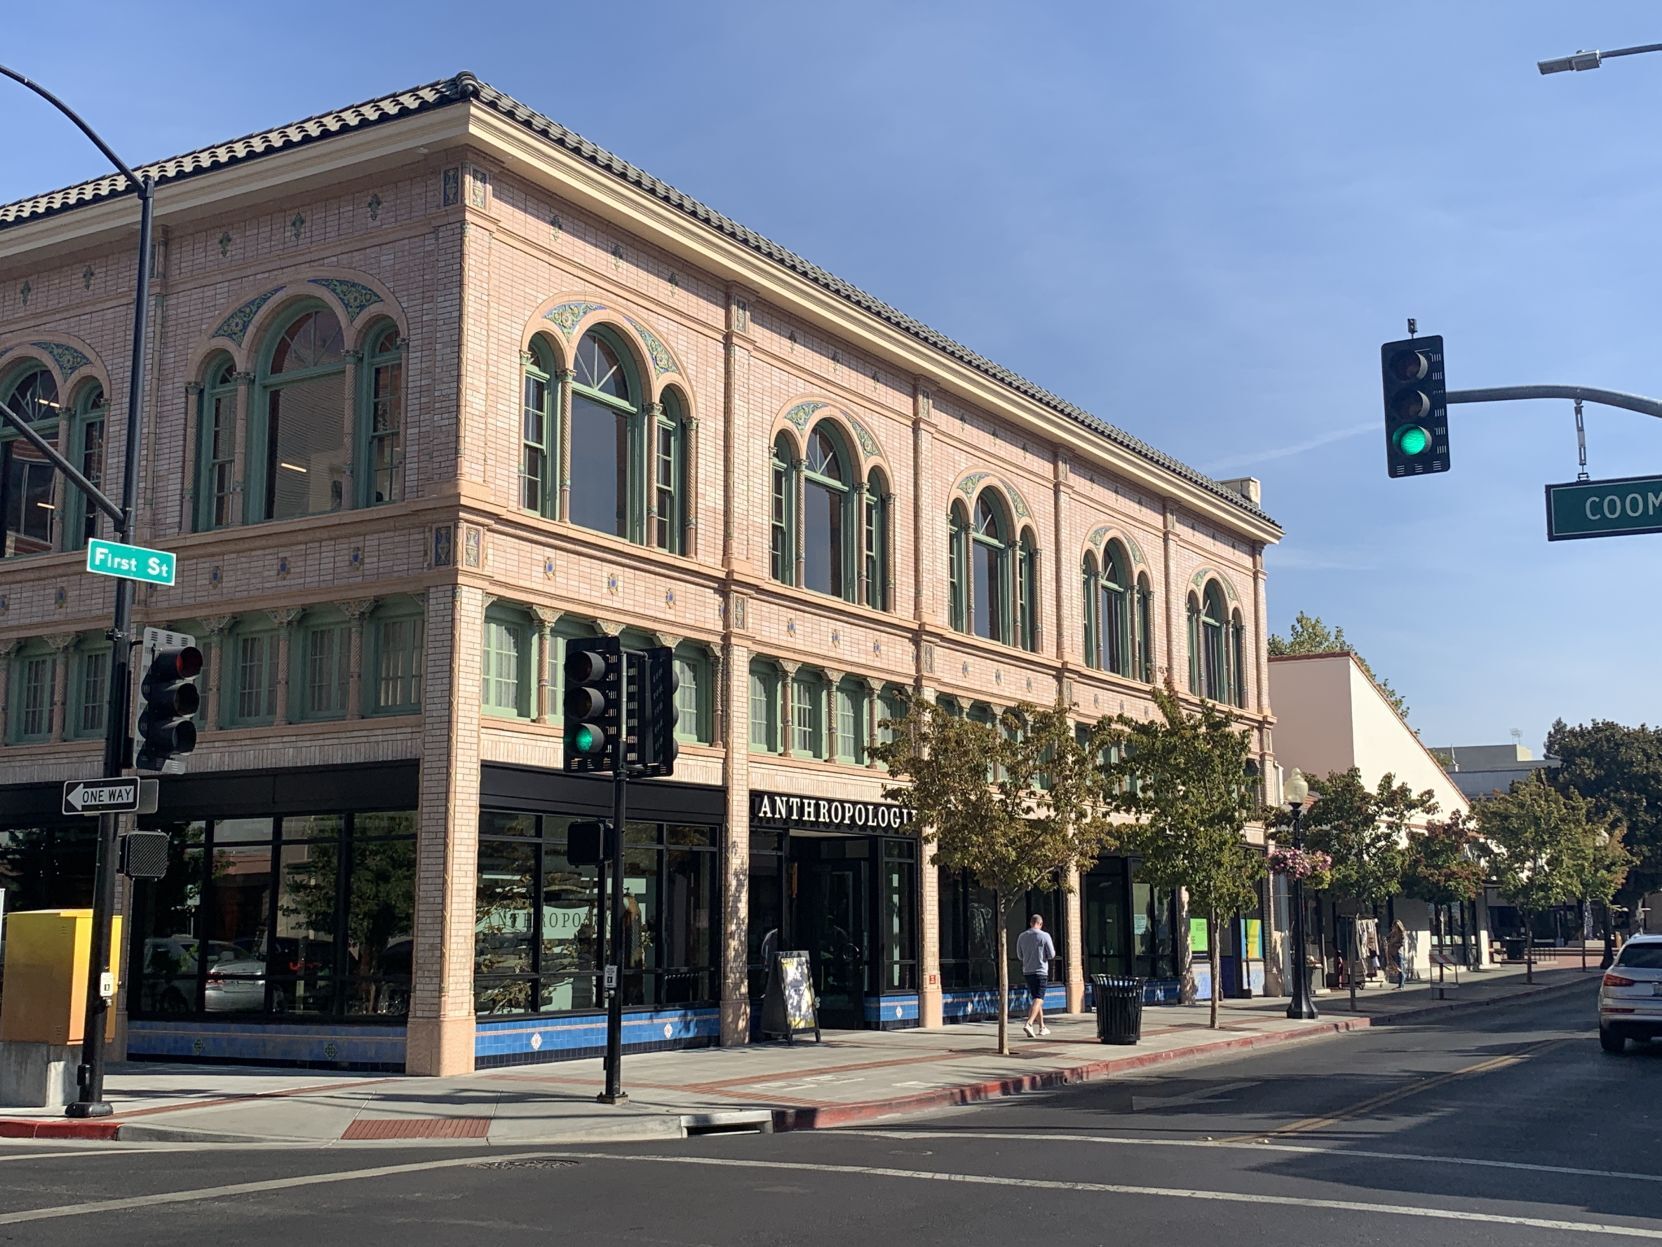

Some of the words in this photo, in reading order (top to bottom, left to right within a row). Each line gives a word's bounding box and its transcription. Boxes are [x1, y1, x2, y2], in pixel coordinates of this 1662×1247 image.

[1585, 492, 1662, 520] COOM
[94, 547, 137, 572] First
[147, 557, 169, 577] St
[82, 789, 105, 803] ONE
[108, 788, 132, 802] WAY
